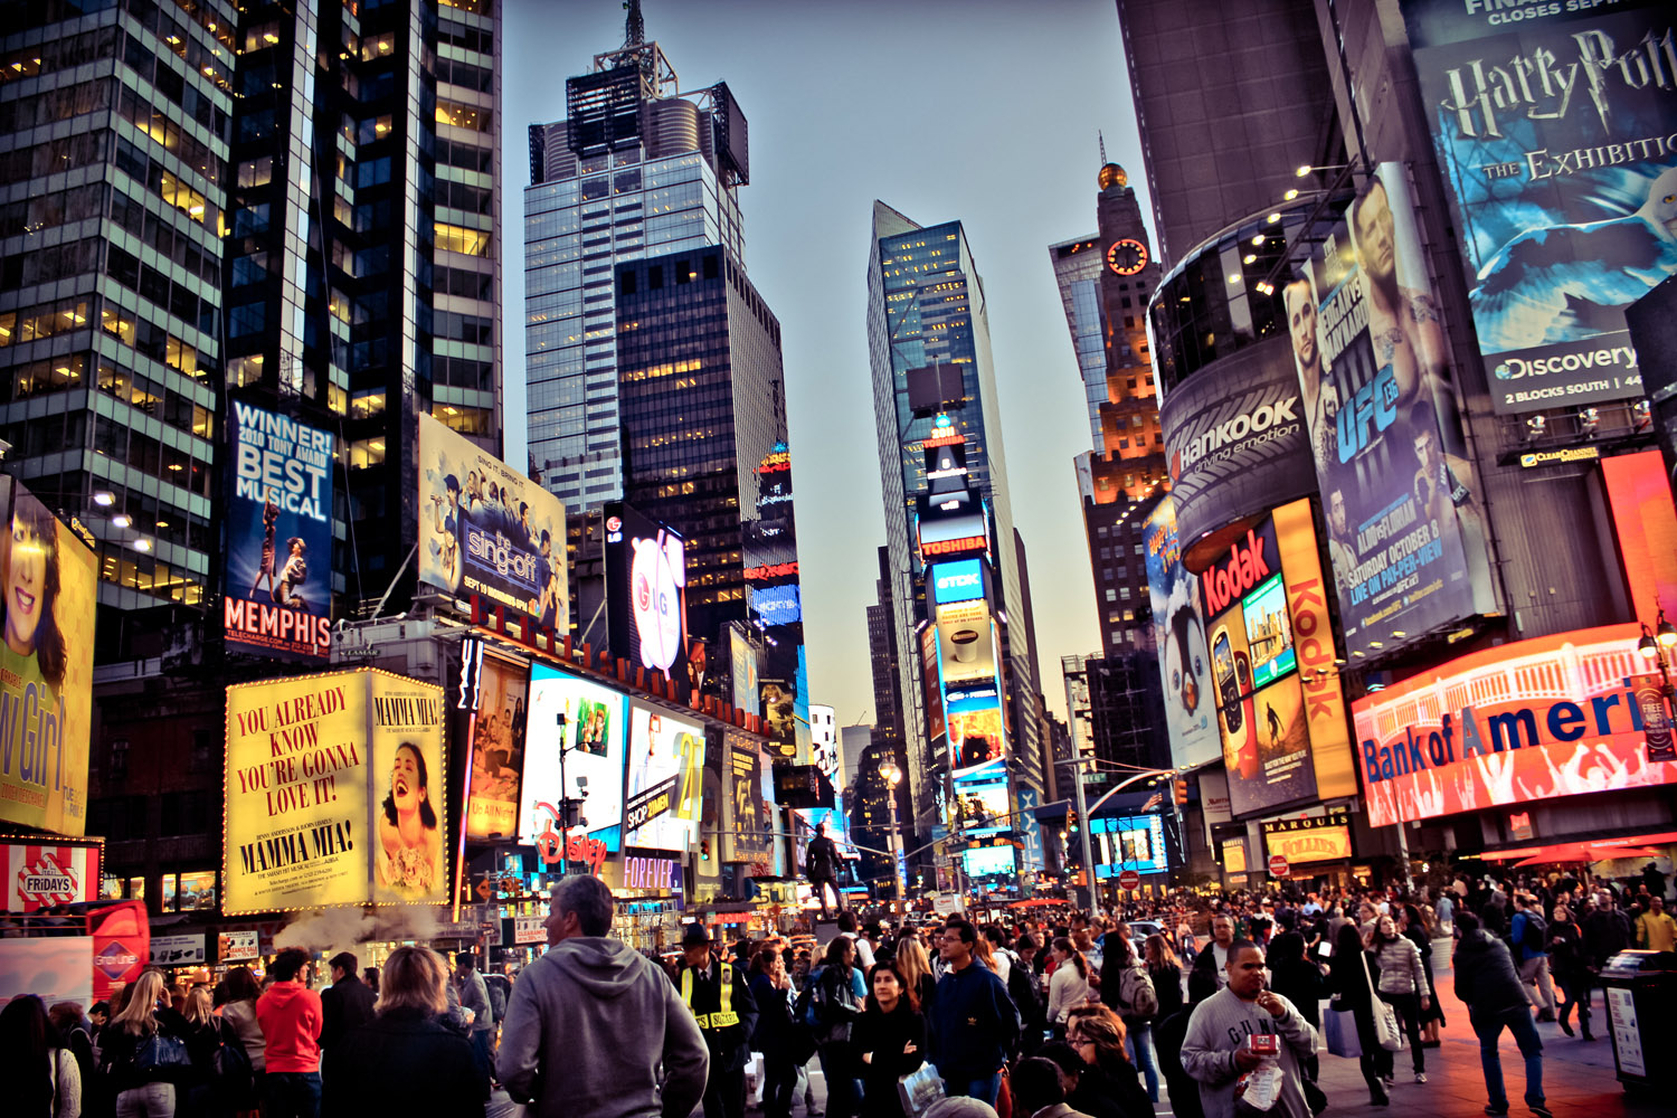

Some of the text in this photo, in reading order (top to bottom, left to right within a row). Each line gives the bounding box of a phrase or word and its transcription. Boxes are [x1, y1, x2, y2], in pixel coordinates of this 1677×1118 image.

[1488, 2, 1561, 26] CLOSES
[1441, 47, 1578, 138] Harry
[1483, 162, 1520, 180] THE
[1505, 346, 1638, 380] Discovery
[1505, 393, 1515, 404] 2
[1516, 385, 1565, 403] BLOCKS
[1567, 379, 1610, 395] SOUTH
[235, 401, 331, 455] WINNER!
[931, 425, 955, 439] 2011
[1337, 364, 1397, 464] UFC
[239, 427, 327, 468] 2010 TONY AWARD
[922, 434, 965, 449] TOSHIBA
[1194, 422, 1300, 474] driving emotion
[237, 442, 327, 500] BEST
[236, 476, 327, 522] MUSICAL
[468, 531, 536, 582] sing-off
[922, 536, 987, 556] TOSHIBA
[1348, 549, 1388, 589] SATURDAY
[1388, 524, 1431, 564] OCTOBER
[1430, 518, 1440, 539] 8
[947, 573, 979, 588] TDK
[1202, 529, 1270, 618] Kodak
[1350, 582, 1369, 606] LIVE
[1367, 574, 1381, 596] ON
[1381, 536, 1442, 589] PAY-PER-VIEW
[224, 596, 331, 647] MEMPHIS
[227, 629, 284, 646] TELECHARGE.COM
[1290, 578, 1338, 721] Kodak
[236, 685, 347, 737] YOU ALREADY
[374, 697, 438, 726] MAMMA MIA!
[20, 680, 65, 792] Girl
[269, 722, 319, 757] KNOW
[1362, 727, 1427, 783] Bank
[1428, 713, 1455, 767] of
[237, 741, 360, 794] YOU'RE GONNA
[266, 774, 337, 817] LOVE IT!
[484, 804, 495, 815] All
[627, 805, 648, 829] SHOP
[536, 802, 607, 877] Disney
[974, 831, 997, 839] SONY
[1264, 815, 1348, 832] MARQUIS
[240, 819, 354, 876] MAMMA MIA!
[624, 856, 673, 888] FOREVER
